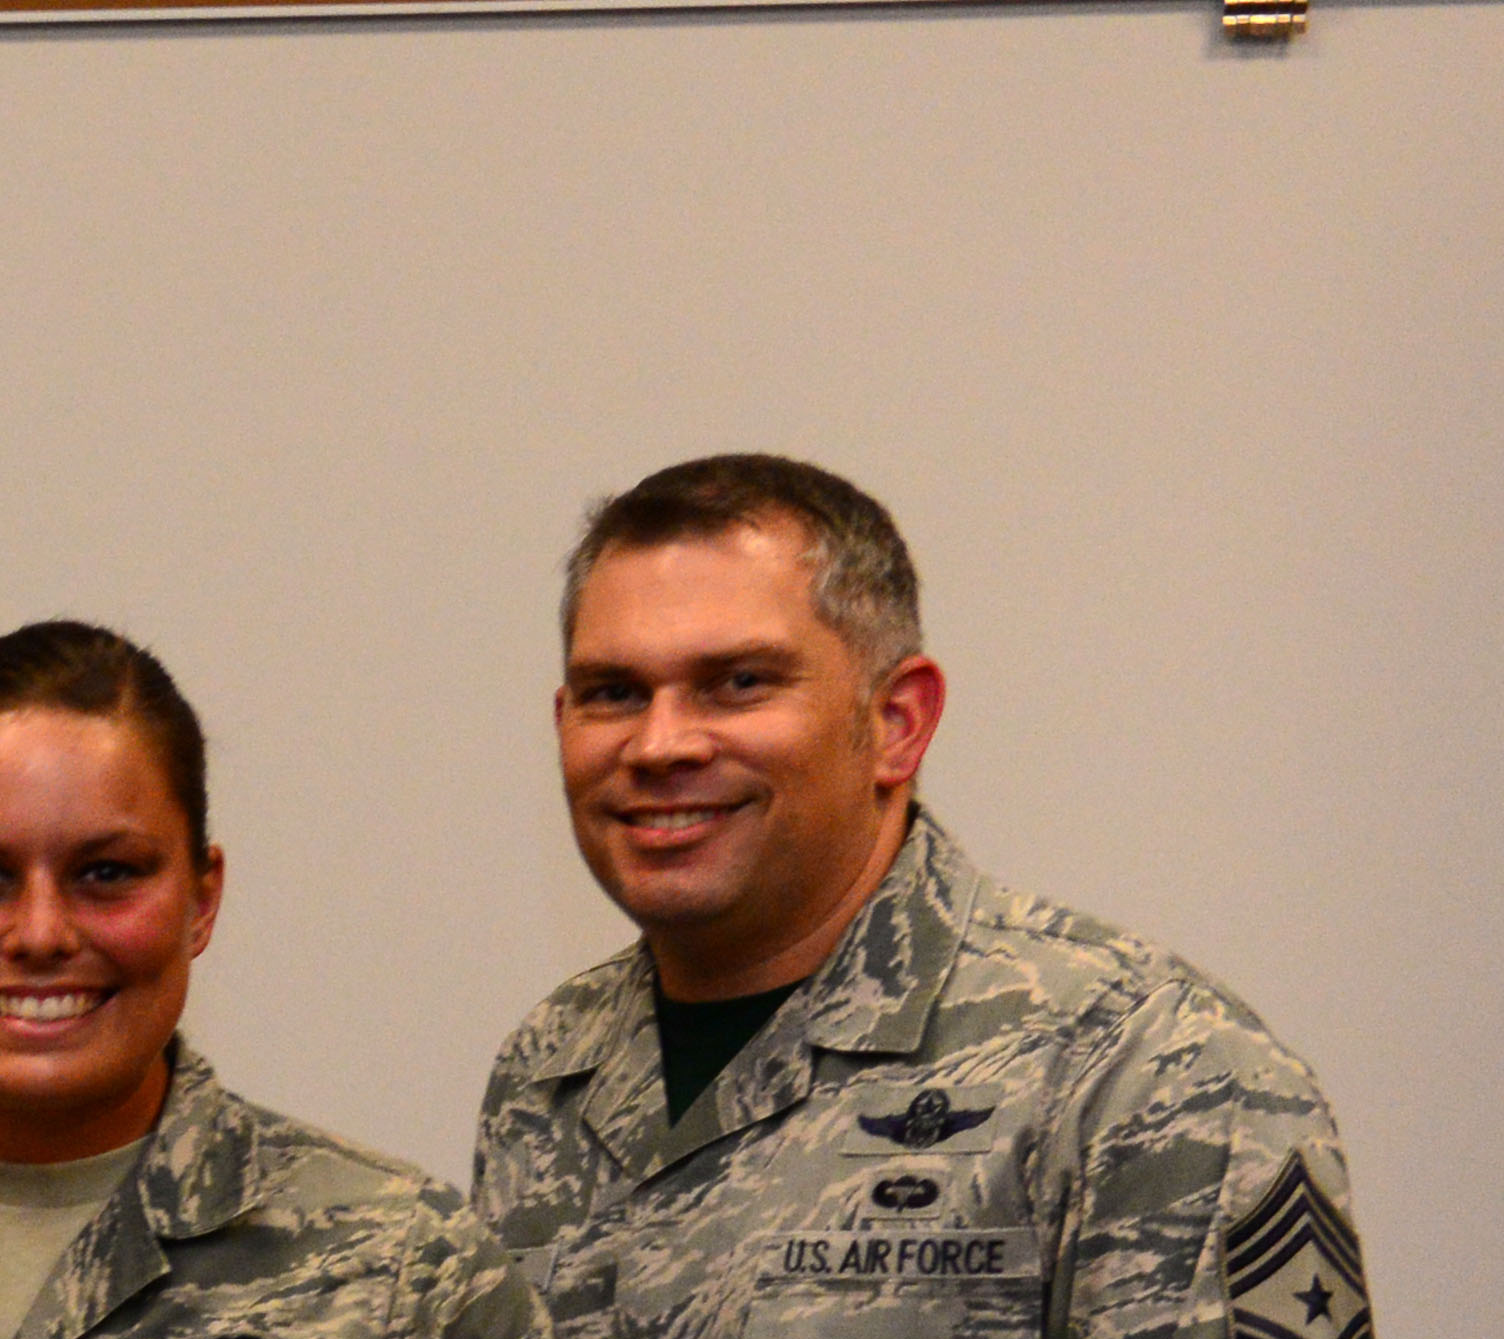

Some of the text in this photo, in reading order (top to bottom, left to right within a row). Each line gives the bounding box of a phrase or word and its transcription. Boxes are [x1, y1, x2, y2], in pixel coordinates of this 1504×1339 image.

[784, 1239, 1006, 1274] U.S. AIR FORCE
